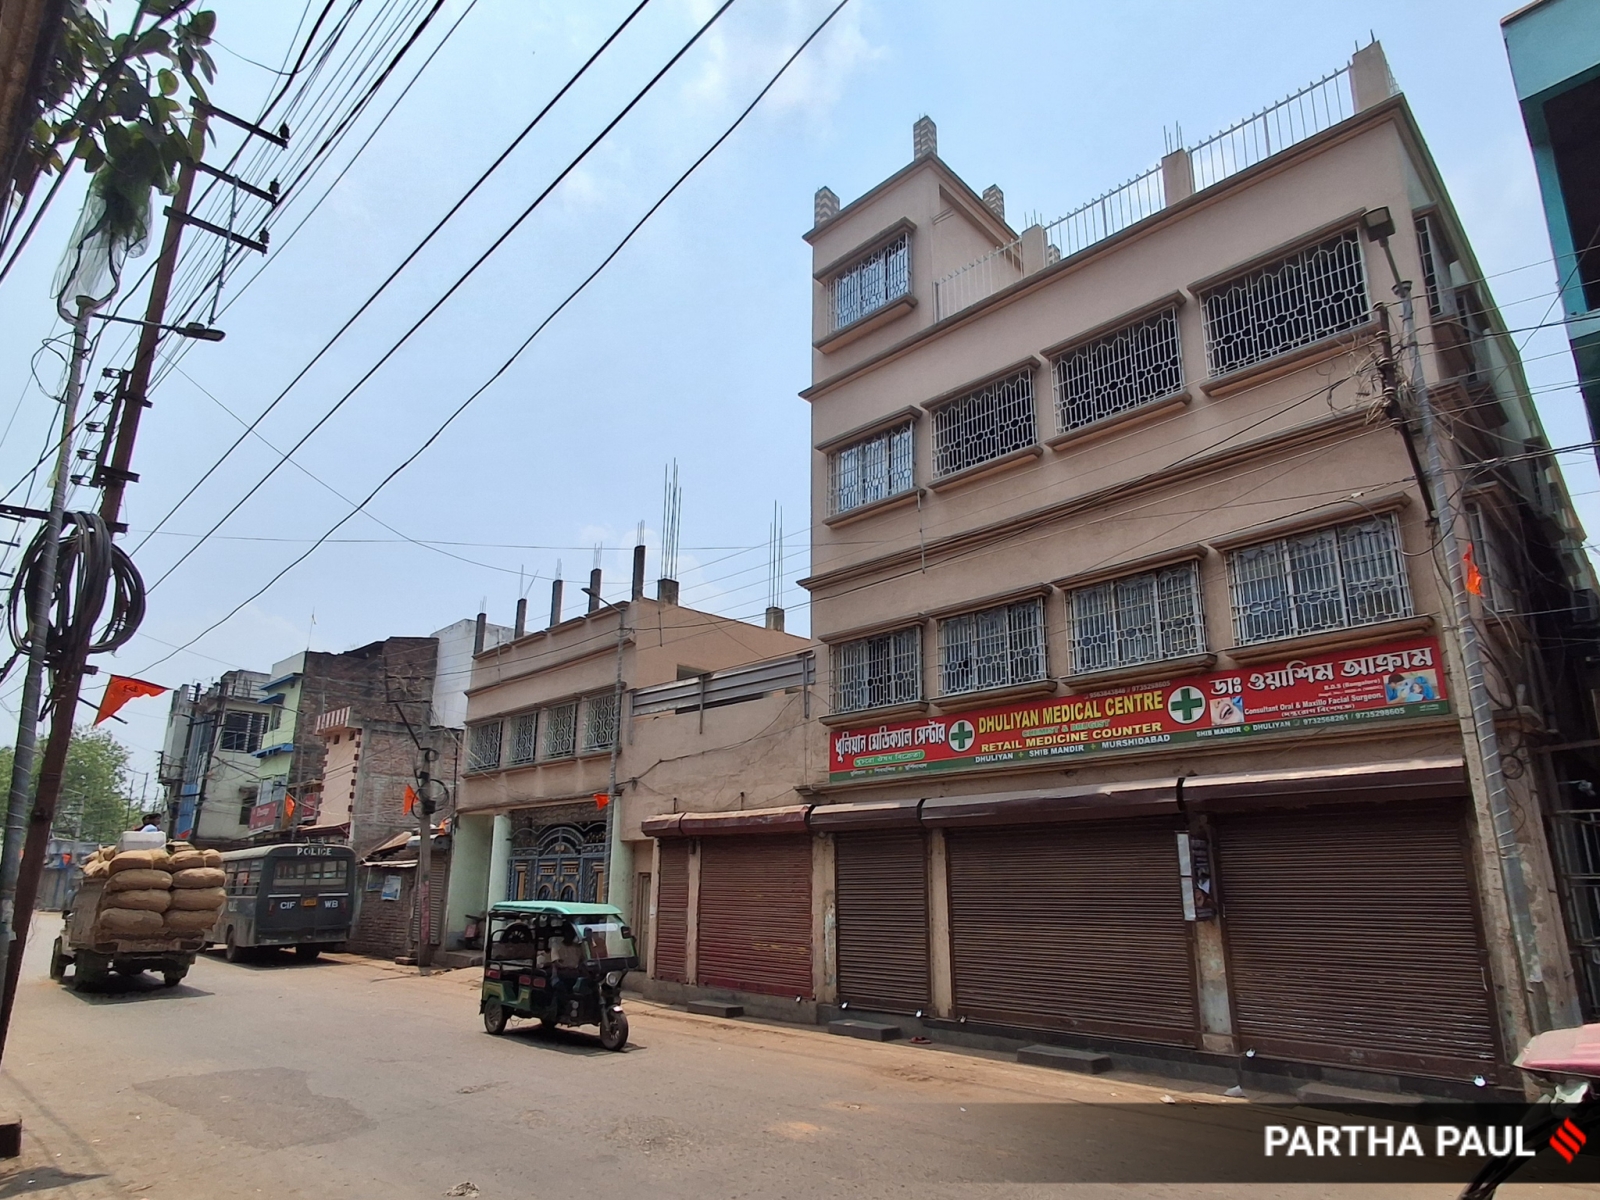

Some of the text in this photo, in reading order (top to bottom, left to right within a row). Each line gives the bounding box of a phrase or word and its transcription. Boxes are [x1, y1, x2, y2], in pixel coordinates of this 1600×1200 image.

[1209, 677, 1243, 695] ডাঃ
[1247, 660, 1334, 690] ওয়াশিম
[1338, 647, 1433, 676] আক্রাম
[978, 690, 1164, 734] DHULIYAN MEDICAL CENTRE
[1244, 705, 1279, 715] Consultant
[1280, 703, 1294, 711] Oral
[1302, 699, 1327, 708] Maxillo
[1328, 696, 1350, 704] Facial
[981, 722, 1163, 753] RETAIL MEDICINE COUNTER
[1061, 724, 1069, 733] &
[1196, 730, 1213, 738] SHIB
[1213, 727, 1242, 736] MANDIR
[1252, 721, 1291, 731] DHULIYAN
[1354, 707, 1406, 719] 9735298605
[835, 719, 947, 763] ধুলিয়ান মেডিক্যাল সেন্টার
[975, 734, 1171, 763] DHULIYAN SHIB MANDIR MURSHIDABAD
[296, 847, 332, 856] POLICE
[280, 901, 296, 909] CIF
[324, 900, 339, 908] WB
